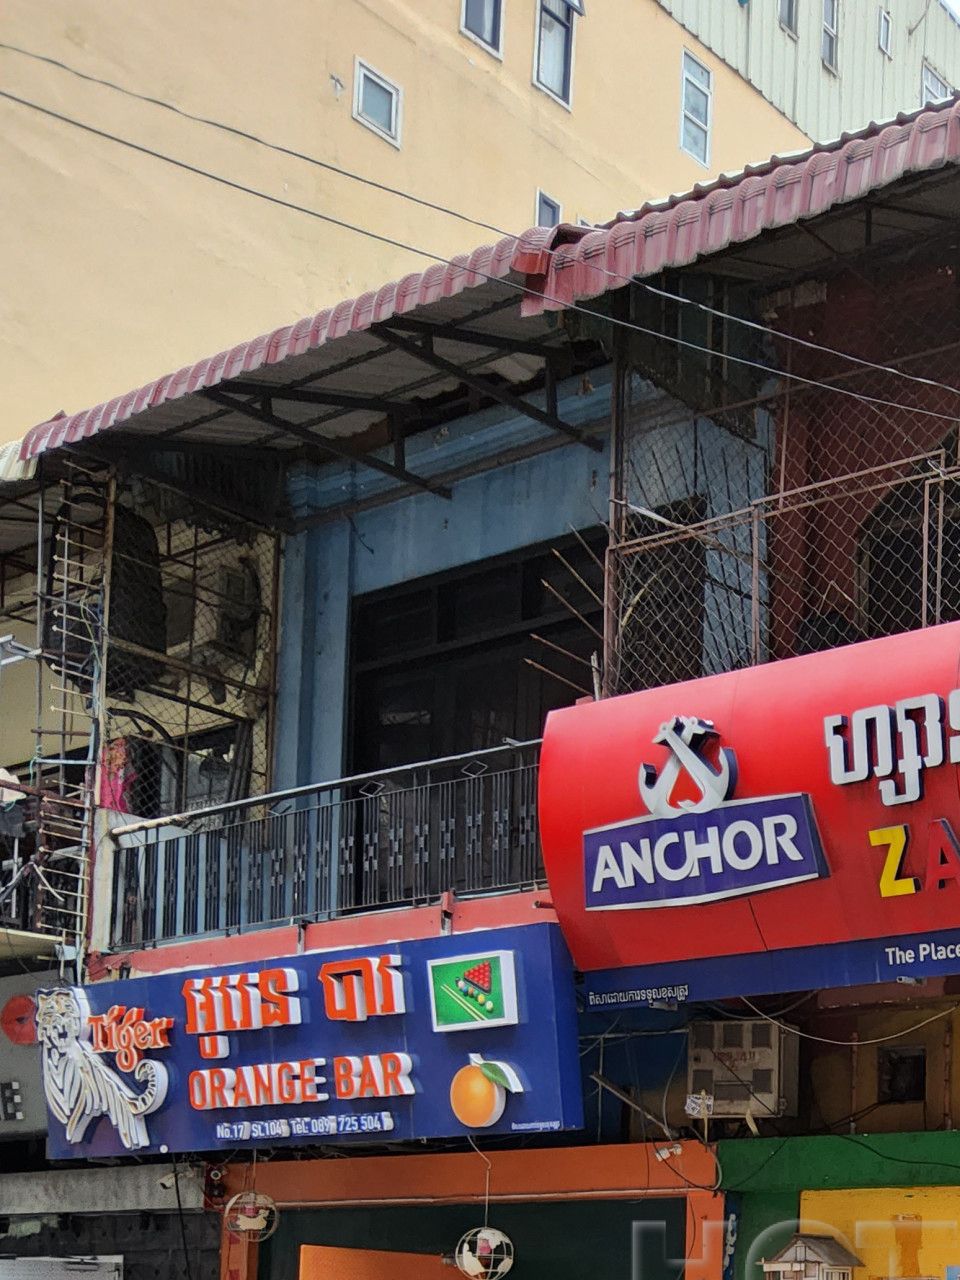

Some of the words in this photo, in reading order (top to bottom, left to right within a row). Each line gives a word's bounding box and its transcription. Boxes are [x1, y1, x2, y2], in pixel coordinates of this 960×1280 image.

[592, 814, 804, 893] ANCHOR
[885, 947, 915, 965] The
[88, 1004, 174, 1073] Tiger
[189, 1058, 328, 1110] ORANGE
[333, 1052, 415, 1100] BAR
[216, 1122, 245, 1140] No.17
[311, 1117, 331, 1134] 089
[337, 1115, 359, 1132] 725
[360, 1114, 382, 1131] 504
